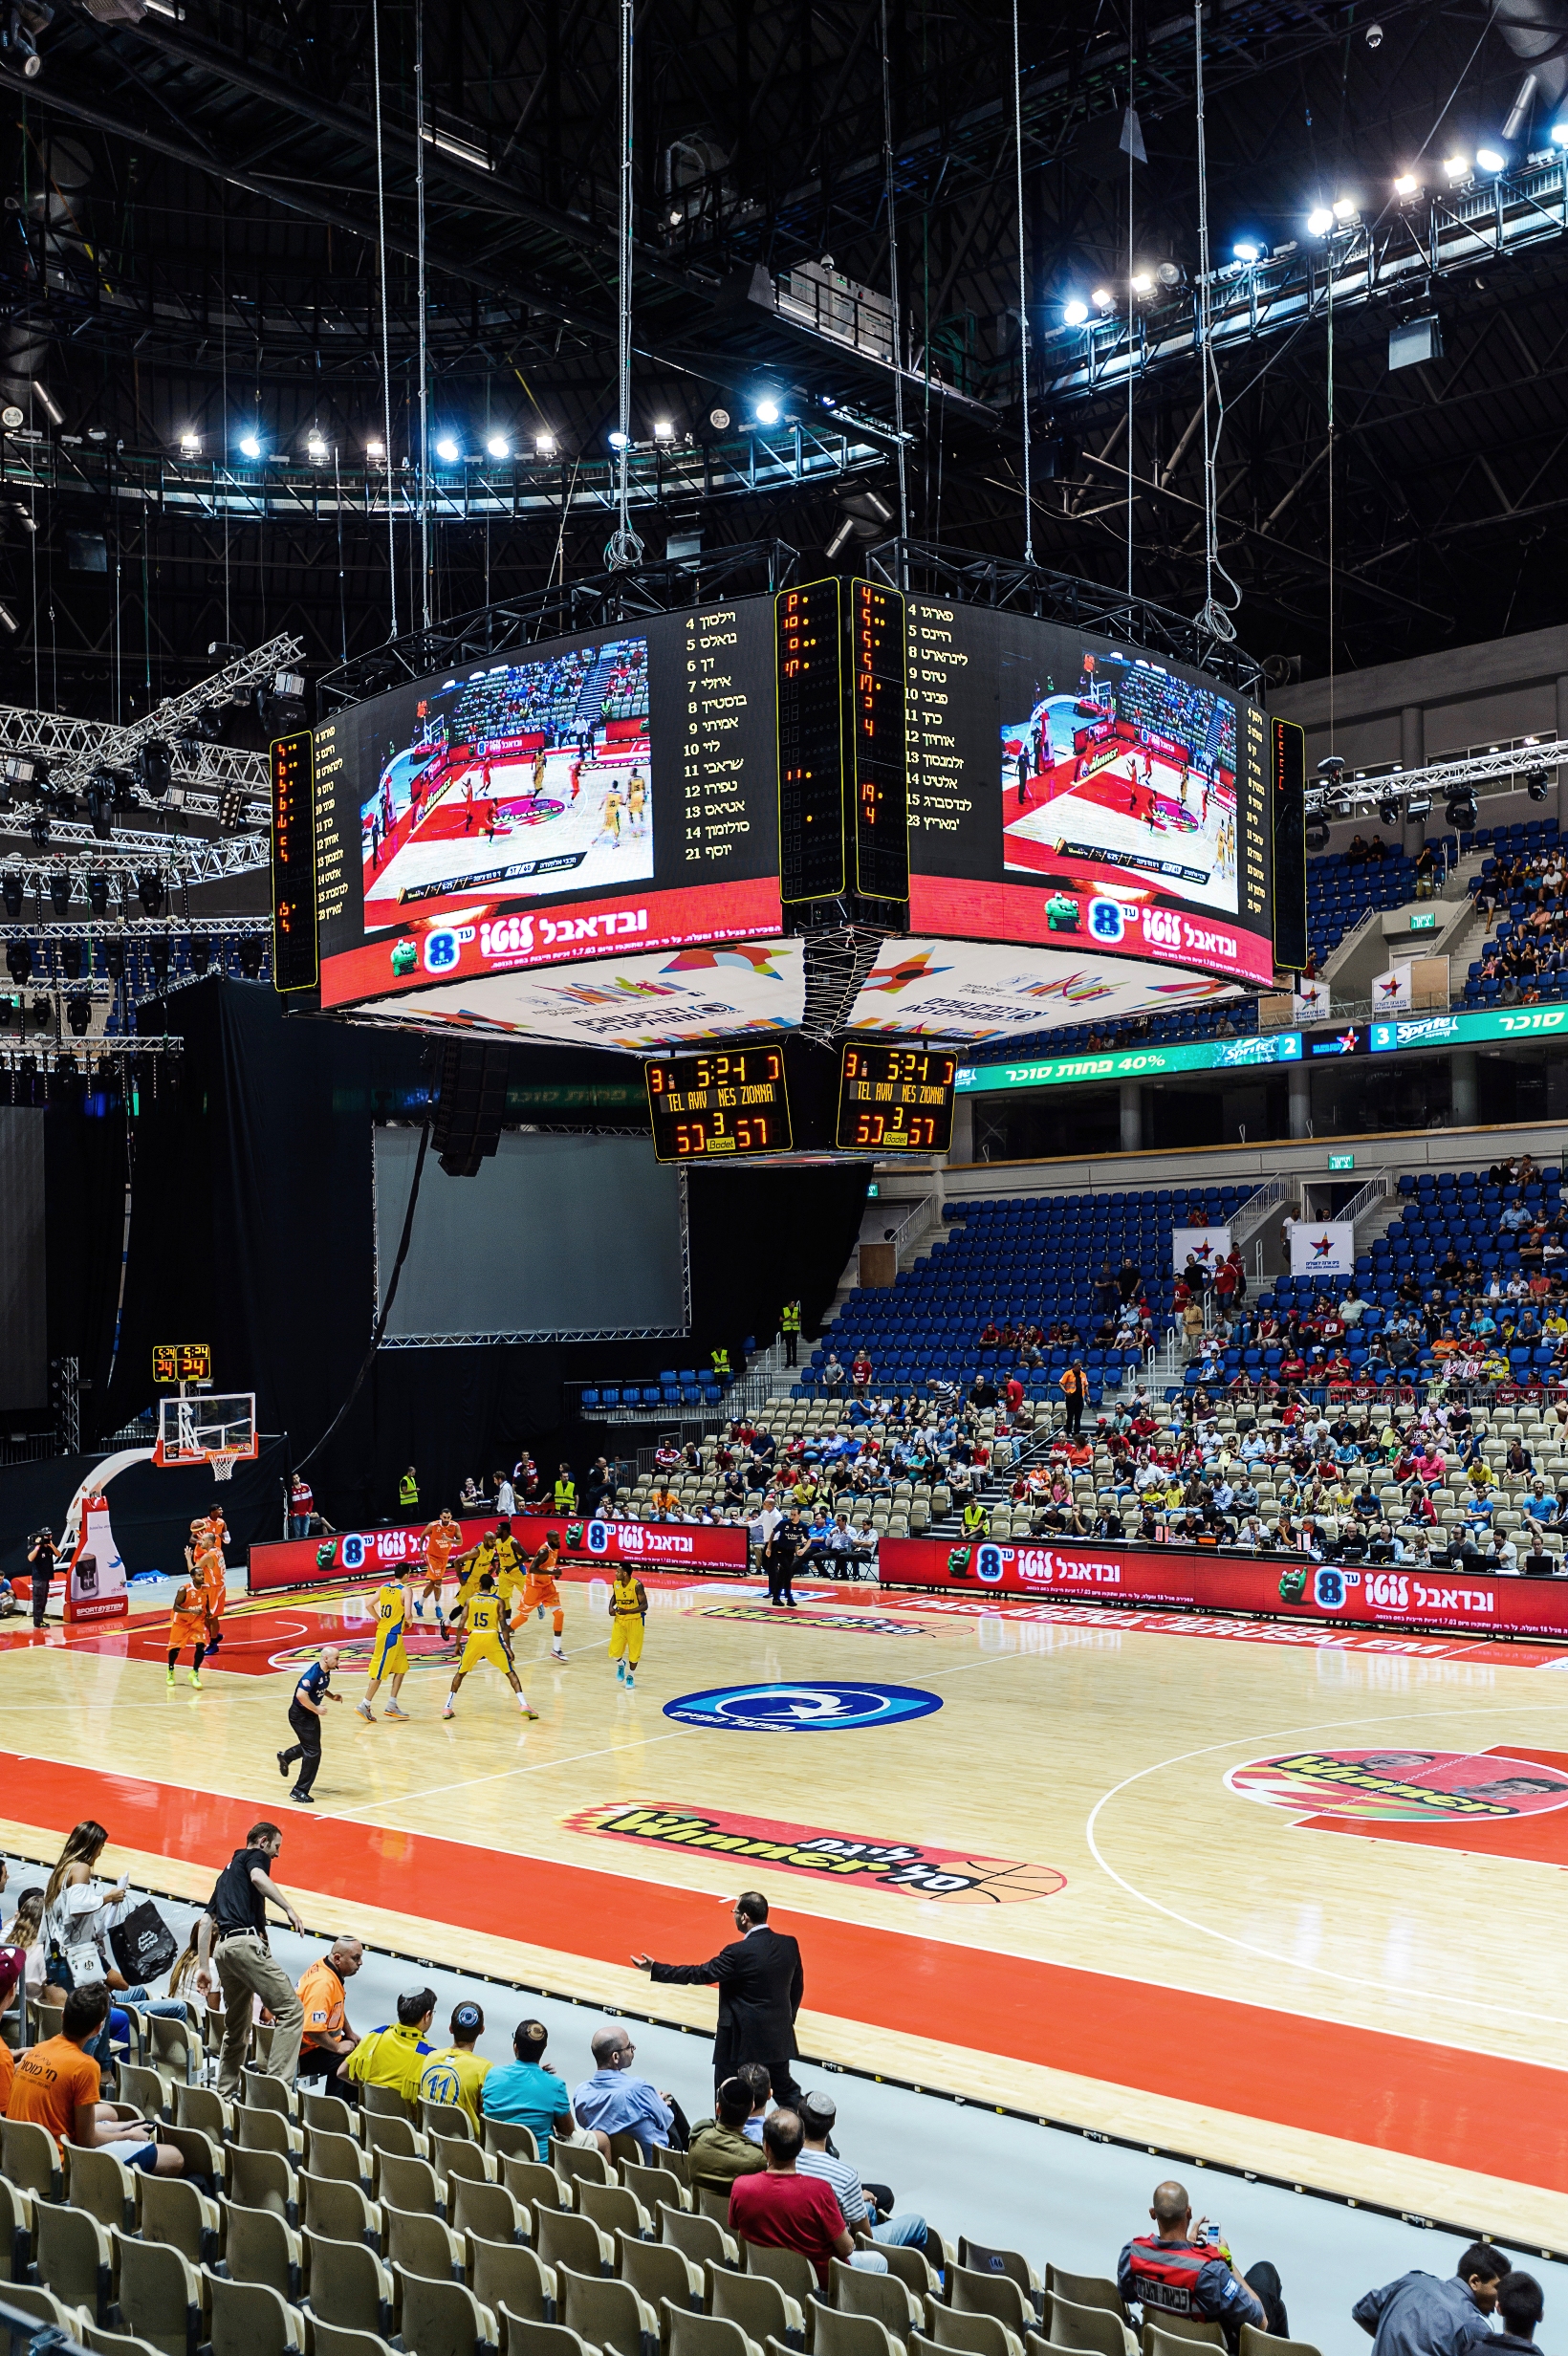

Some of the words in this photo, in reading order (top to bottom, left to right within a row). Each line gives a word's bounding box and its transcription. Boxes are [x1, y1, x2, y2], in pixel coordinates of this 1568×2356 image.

[908, 604, 916, 616] 4
[686, 618, 694, 629] 4
[699, 612, 735, 630] וילסון
[908, 625, 917, 637] 5
[686, 639, 695, 651] 5
[700, 633, 737, 648] נואלס
[908, 646, 917, 658] 8
[687, 661, 696, 671] 6
[701, 658, 714, 672] דן
[909, 667, 917, 679] 9
[687, 681, 696, 692] 7
[701, 676, 731, 689] איזלי
[904, 687, 918, 700] 10
[688, 702, 697, 713] 8
[702, 695, 747, 713] בוסטיין
[904, 709, 918, 722] 11
[689, 723, 697, 734] 9
[703, 717, 738, 731] אמיתי
[905, 730, 919, 742] 12
[684, 744, 699, 756] 10
[703, 740, 720, 753] לוי
[905, 751, 919, 764] 13
[685, 765, 699, 777] 11
[704, 758, 744, 774] שראבי
[906, 772, 919, 784] 14
[685, 785, 700, 797] 12
[704, 780, 737, 795] טפירו
[686, 806, 701, 818] 13
[705, 800, 745, 816] אטיאס
[906, 794, 920, 806] 15
[906, 815, 920, 826] 23
[686, 827, 701, 840] 14
[706, 821, 750, 839] סולומון
[686, 848, 701, 860] 21
[706, 844, 731, 860] יוסף
[539, 909, 647, 945] ובדאבל
[1092, 901, 1122, 939] 8
[1143, 908, 1181, 947] לוטו
[1413, 915, 1432, 927] יציאה
[480, 916, 534, 955] לוטו
[1185, 923, 1237, 957] ובדאבל
[427, 931, 457, 968] 8
[1397, 1016, 1450, 1040] Sprite
[1499, 1012, 1564, 1031] סוכר
[1285, 1037, 1296, 1054] 2
[1377, 1028, 1389, 1044] 3
[846, 1054, 858, 1077] 3
[1056, 1059, 1114, 1078] פחות
[1118, 1055, 1165, 1071] 40%
[652, 1070, 663, 1092] 3
[1006, 1066, 1053, 1082] סוכר
[667, 1093, 685, 1112] TEL
[687, 1090, 708, 1109] AVIV
[718, 1088, 736, 1107] NES
[858, 1081, 871, 1100] TEL
[875, 1082, 893, 1101] AVIV
[902, 1084, 917, 1102] NES
[713, 1112, 724, 1135] 3
[892, 1106, 904, 1129] 3
[1331, 1156, 1351, 1169] יציאה
[589, 1520, 608, 1550] 8
[619, 1525, 644, 1550] לוטו
[646, 1531, 693, 1552] ובדאבל
[344, 1537, 364, 1565] 8
[378, 1532, 406, 1558] לוטו
[979, 1546, 1002, 1579] 8
[1017, 1549, 1054, 1579] לוטו
[1056, 1557, 1121, 1582] ובדאבל
[1318, 1570, 1342, 1604] 8
[1365, 1573, 1409, 1607] לוטו
[1413, 1582, 1494, 1612] ובדאבל
[76, 1603, 124, 1616] SPORTSYSTEM
[381, 1604, 392, 1619] 10
[474, 1612, 489, 1626] 15
[898, 1600, 999, 1614] PAIS
[1000, 1607, 1137, 1627] ARENA
[1143, 1622, 1450, 1654] JERUSALEM
[1275, 1755, 1512, 1815] Winner
[608, 1810, 893, 1874] Winner
[800, 1838, 916, 1862] ליגת
[887, 1862, 970, 1890] סל
[46, 2068, 57, 2083] חי
[427, 2074, 451, 2104] 11
